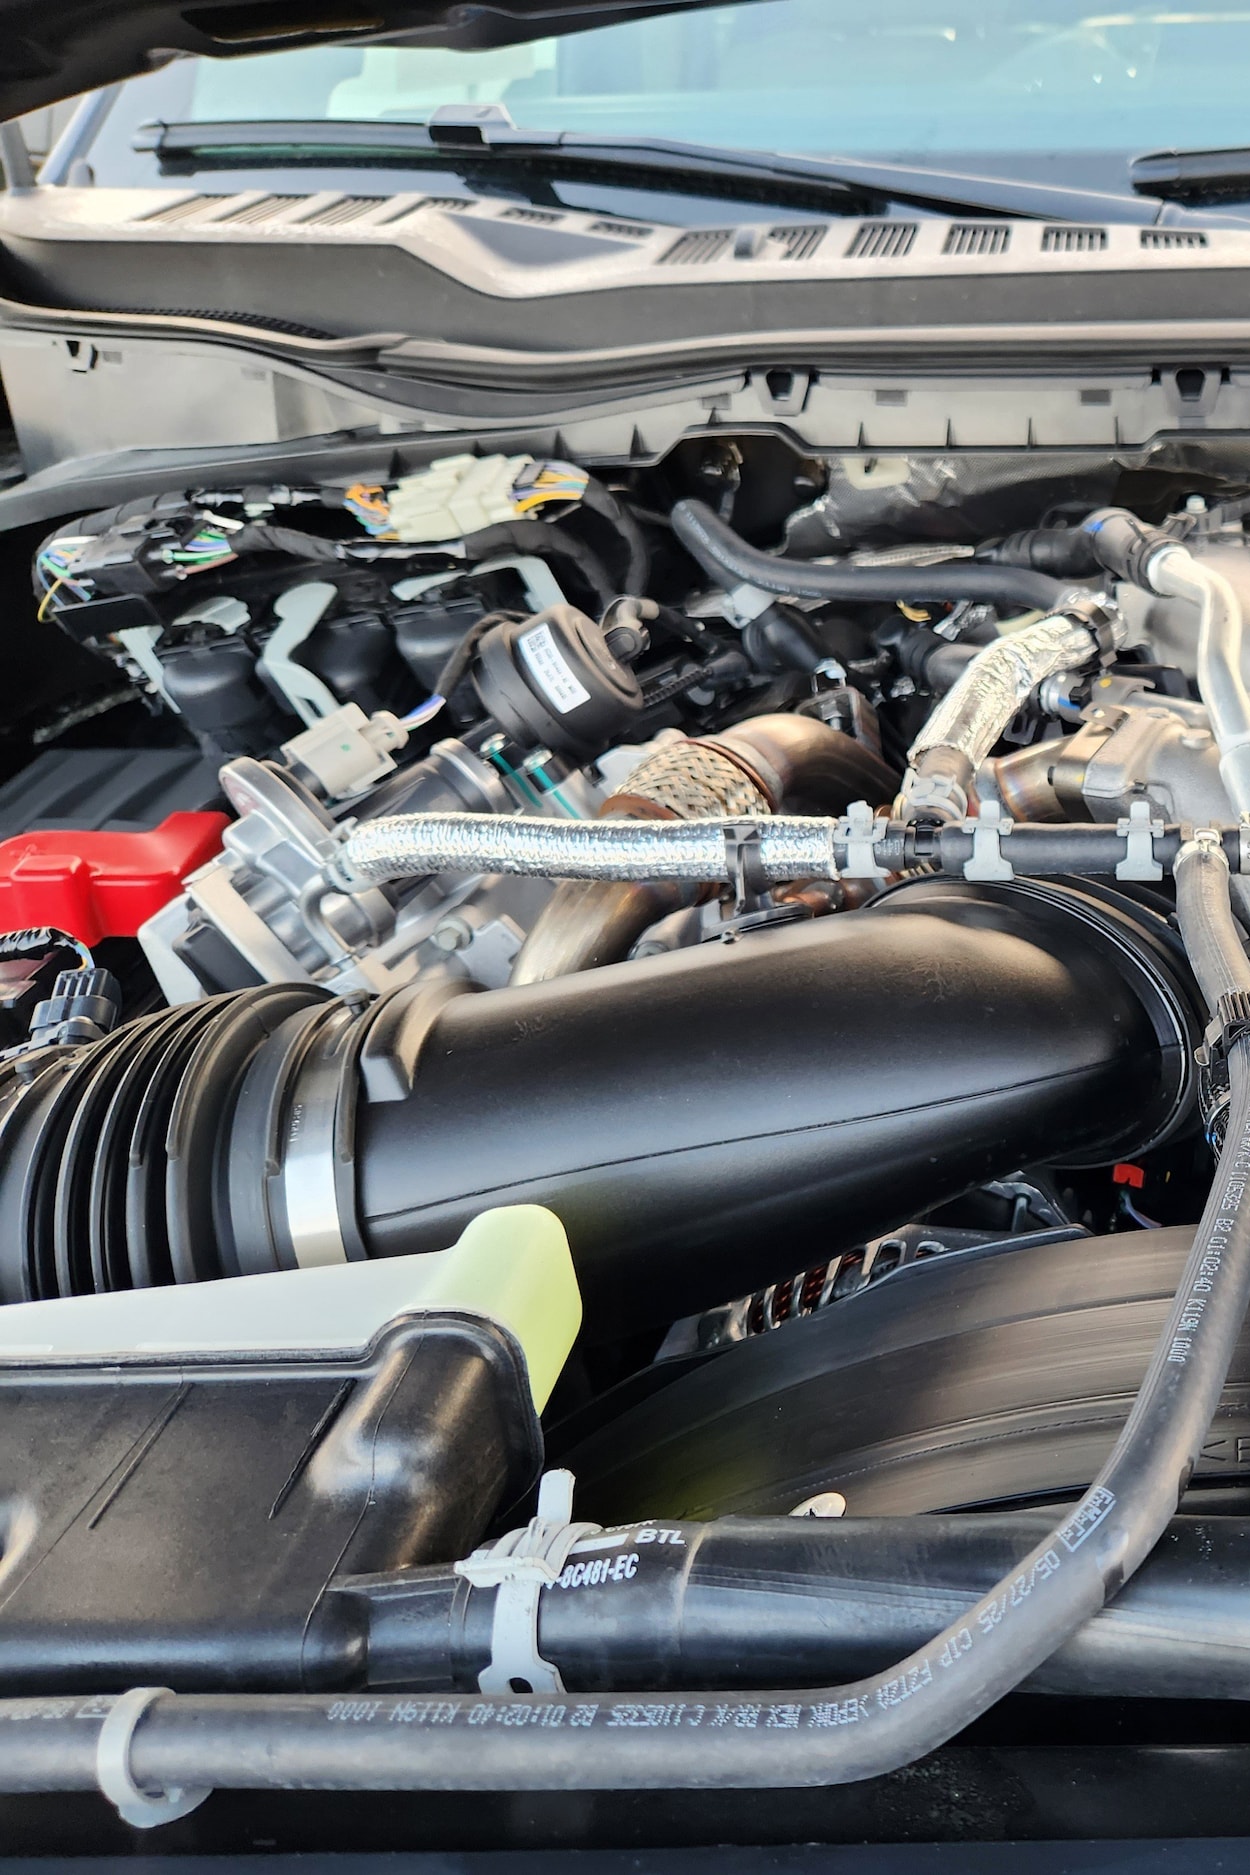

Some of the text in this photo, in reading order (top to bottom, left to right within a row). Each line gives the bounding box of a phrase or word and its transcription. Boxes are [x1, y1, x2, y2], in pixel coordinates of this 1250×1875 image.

[1166, 1335, 1194, 1365] 1000
[634, 1528, 686, 1545] BTL
[974, 1546, 1061, 1635] 05/27/25
[324, 1700, 384, 1722] 1000
[466, 1703, 567, 1728] 01:02:40
